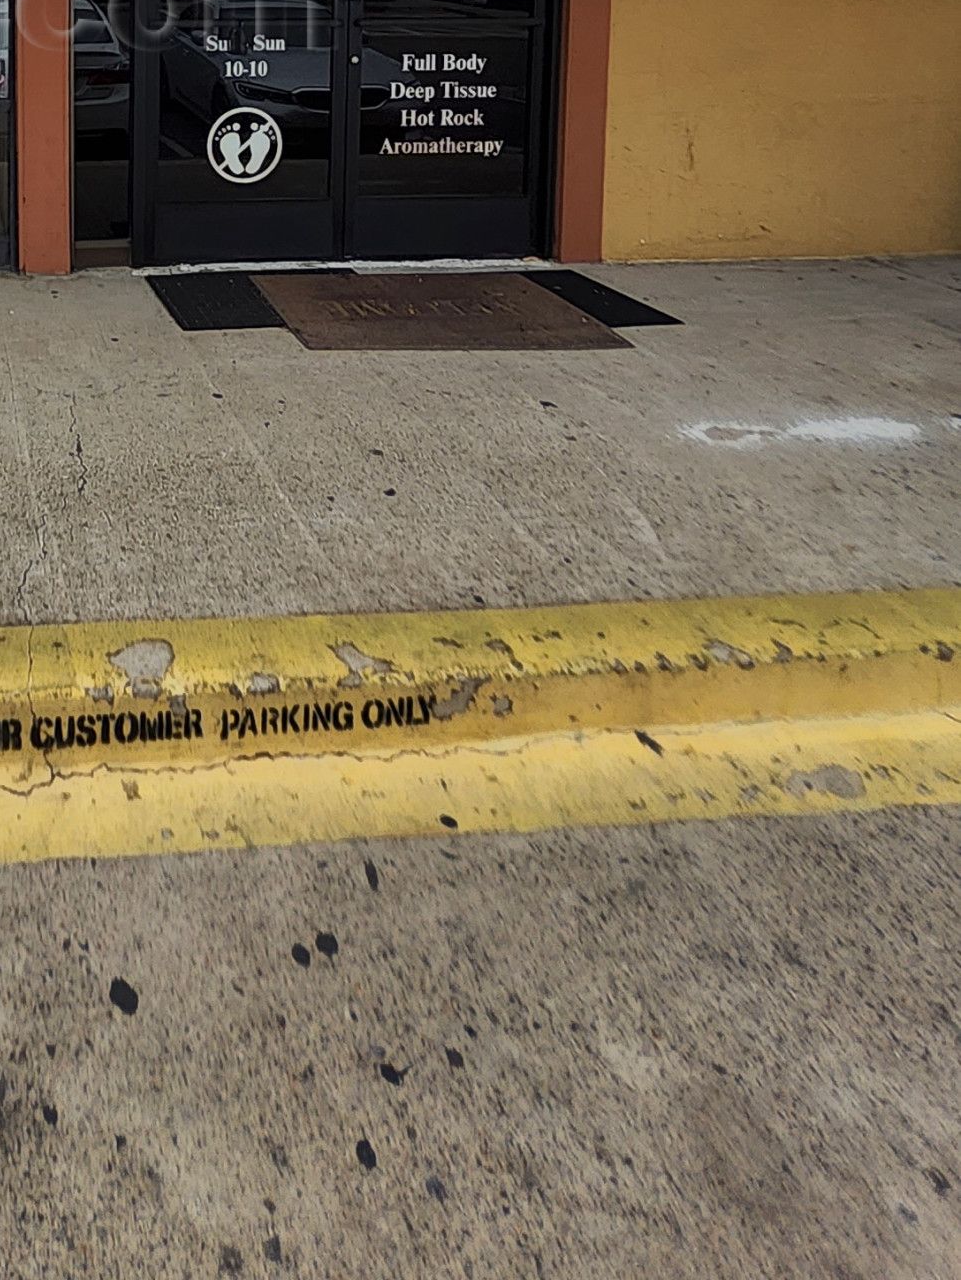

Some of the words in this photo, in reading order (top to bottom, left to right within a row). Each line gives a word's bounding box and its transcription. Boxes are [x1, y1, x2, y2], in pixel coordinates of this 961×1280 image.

[206, 35, 232, 51] Su
[253, 34, 285, 51] Sun
[224, 60, 268, 77] 10-10
[402, 54, 436, 71] Full
[442, 54, 487, 74] Body
[390, 82, 435, 102] Deep
[440, 81, 497, 98] Tissue
[400, 109, 435, 127] Hot
[440, 109, 484, 126] Rock
[379, 137, 504, 157] Aromatherapy
[30, 708, 203, 749] CUSTOMER
[219, 701, 354, 741] PARKING
[360, 694, 436, 730] ONLY
